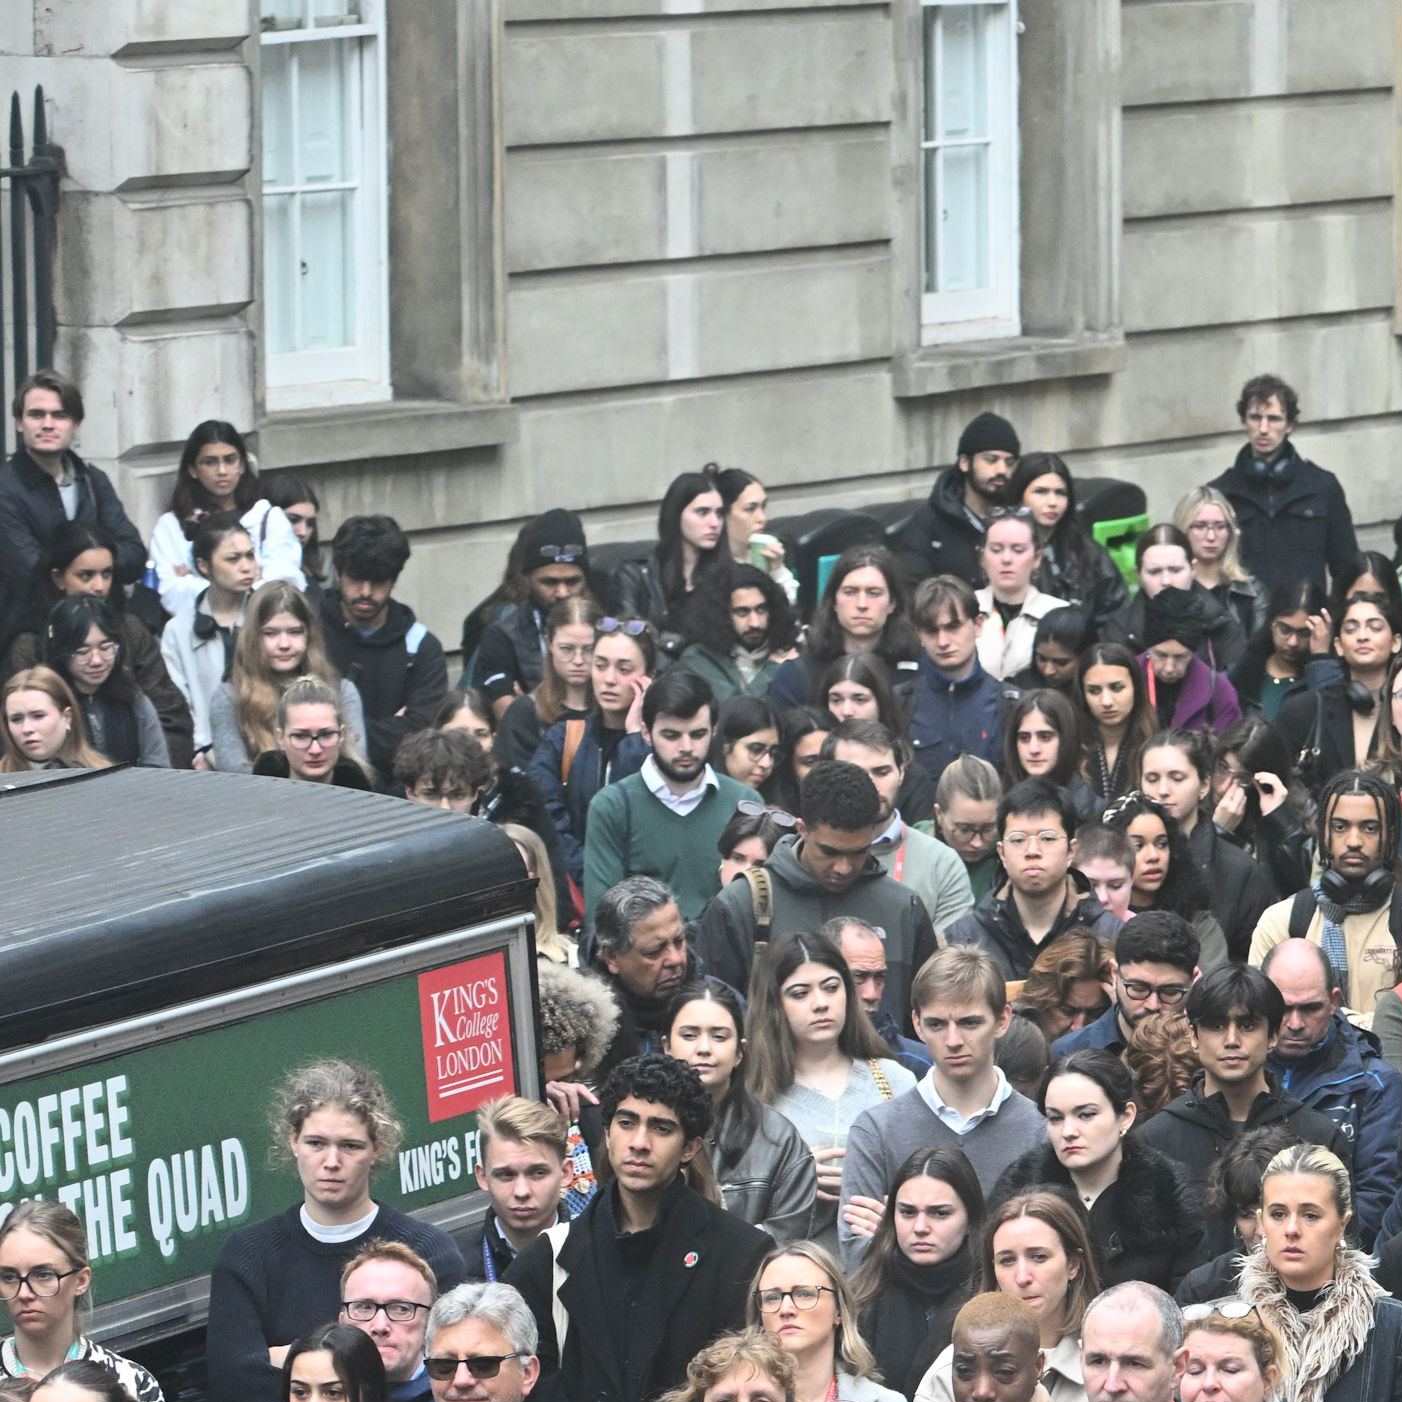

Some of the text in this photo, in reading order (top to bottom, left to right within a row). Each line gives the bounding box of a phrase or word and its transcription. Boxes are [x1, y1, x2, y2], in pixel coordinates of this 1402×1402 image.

[430, 977, 498, 1047] KING'S
[456, 1011, 500, 1042] College
[436, 1039, 503, 1080] LONDON
[399, 1136, 461, 1195] KING'S
[58, 1137, 248, 1260] THE QUAD
